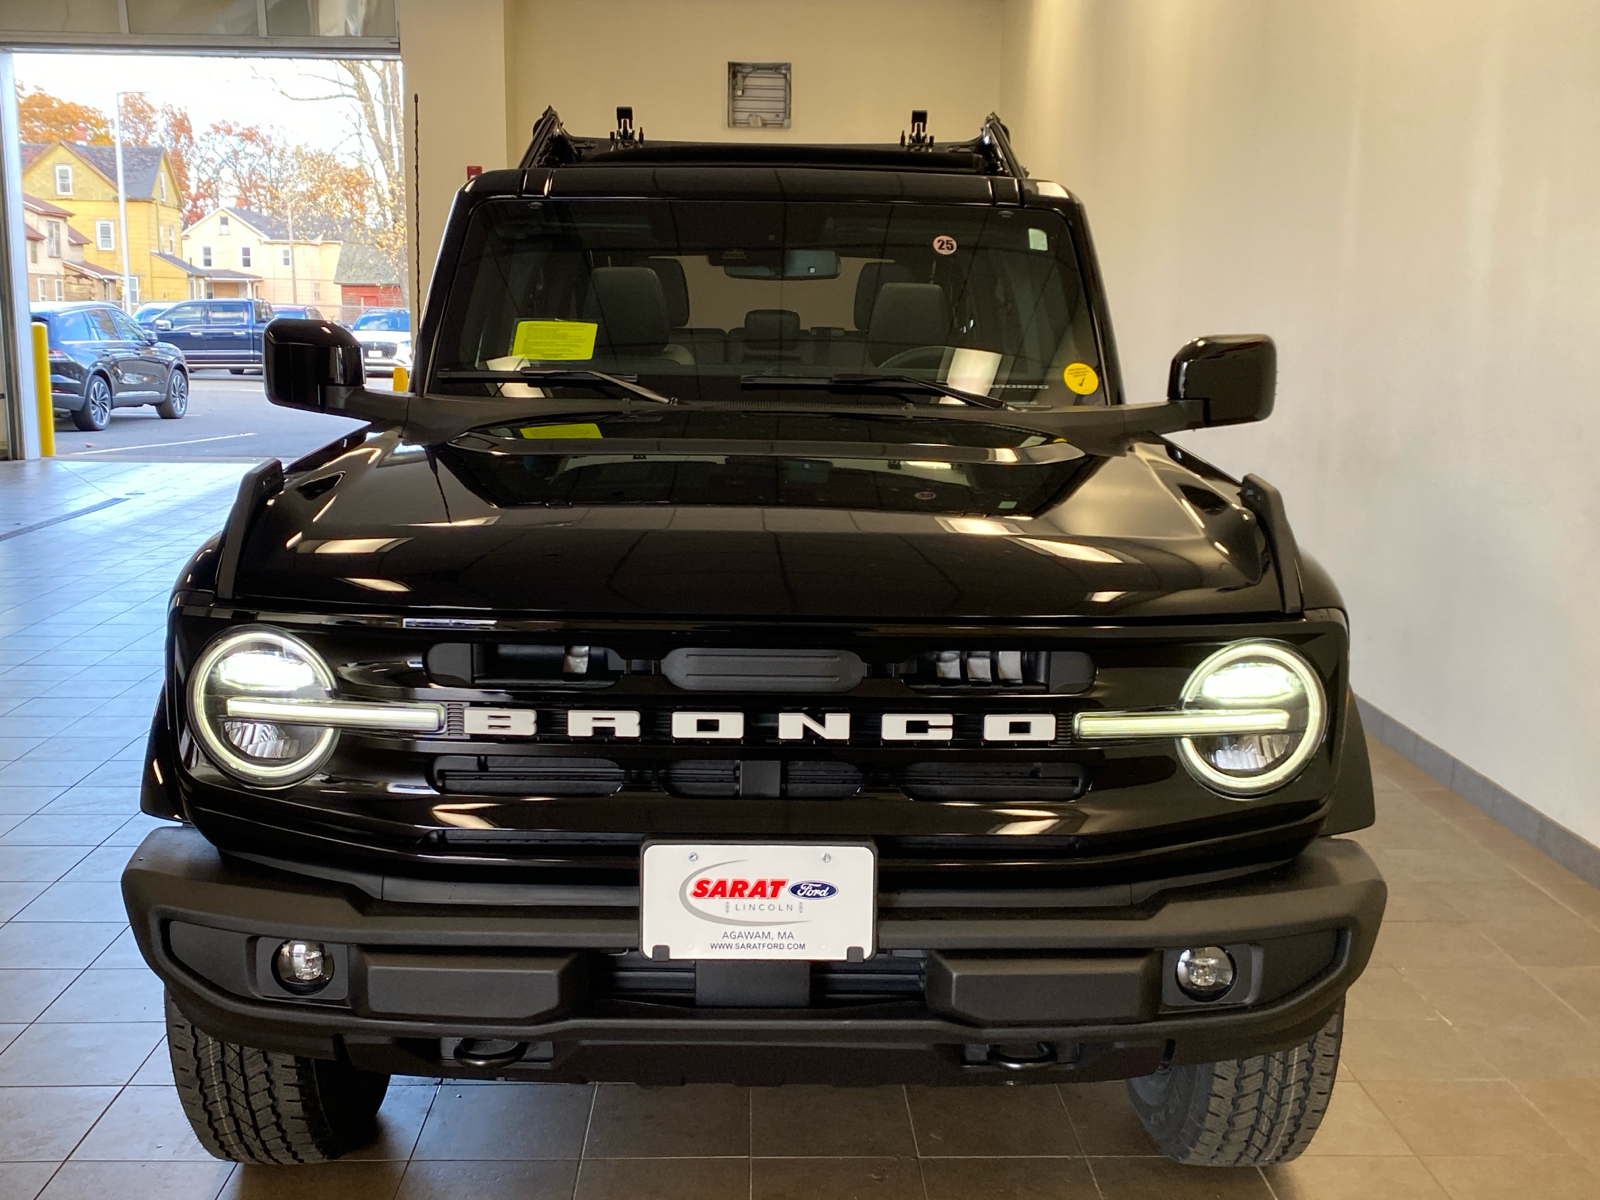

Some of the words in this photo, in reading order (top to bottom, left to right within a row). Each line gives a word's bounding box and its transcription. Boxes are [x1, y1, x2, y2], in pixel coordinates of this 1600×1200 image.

[937, 239, 954, 251] 25
[463, 708, 1057, 742] BRONCO
[690, 878, 788, 898] SARAT
[796, 881, 830, 898] Ford
[735, 903, 793, 911] LINCOLN
[721, 931, 774, 941] AGAWAM,
[777, 931, 795, 940] MA
[709, 942, 806, 950] WWW.SARATFORD.COM
